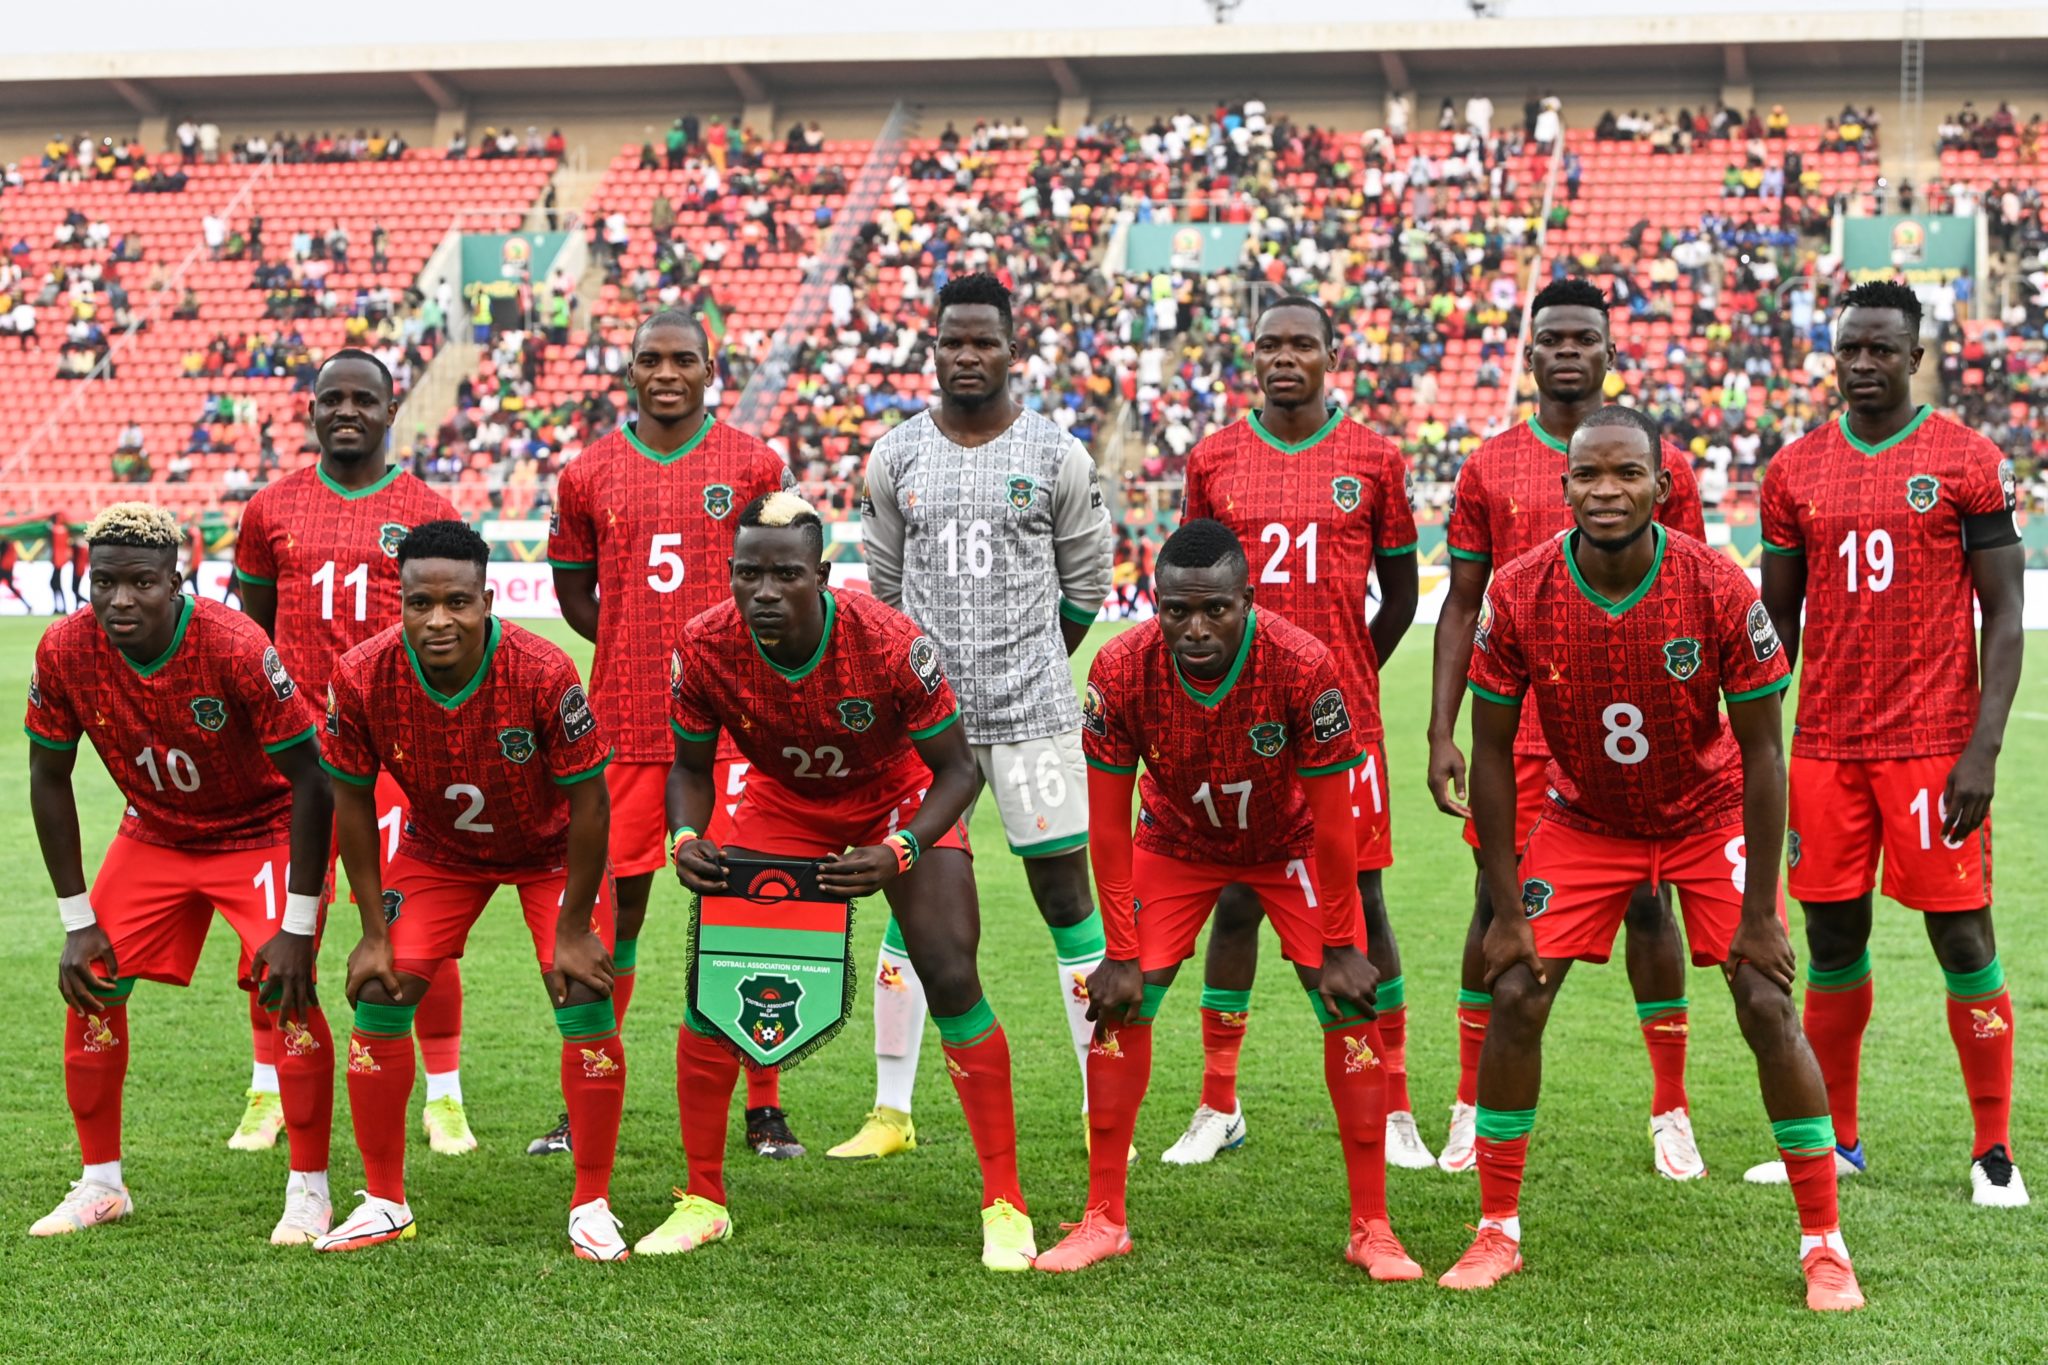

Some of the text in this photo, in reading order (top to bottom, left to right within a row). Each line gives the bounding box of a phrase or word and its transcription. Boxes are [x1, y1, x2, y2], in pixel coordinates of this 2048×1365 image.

[646, 533, 685, 594] 5
[938, 518, 994, 578] 16
[1259, 522, 1318, 584] 21
[1838, 529, 1895, 593] 19
[311, 560, 368, 622] 11
[782, 745, 851, 779] 22
[1602, 702, 1650, 764] 8
[135, 747, 201, 793] 10
[1007, 750, 1066, 814] 16
[444, 783, 494, 833] 2
[1192, 779, 1253, 829] 17
[712, 960, 746, 969] FOOTBALL
[747, 962, 791, 972] ASSOCIATION
[802, 965, 831, 974] MALAWI
